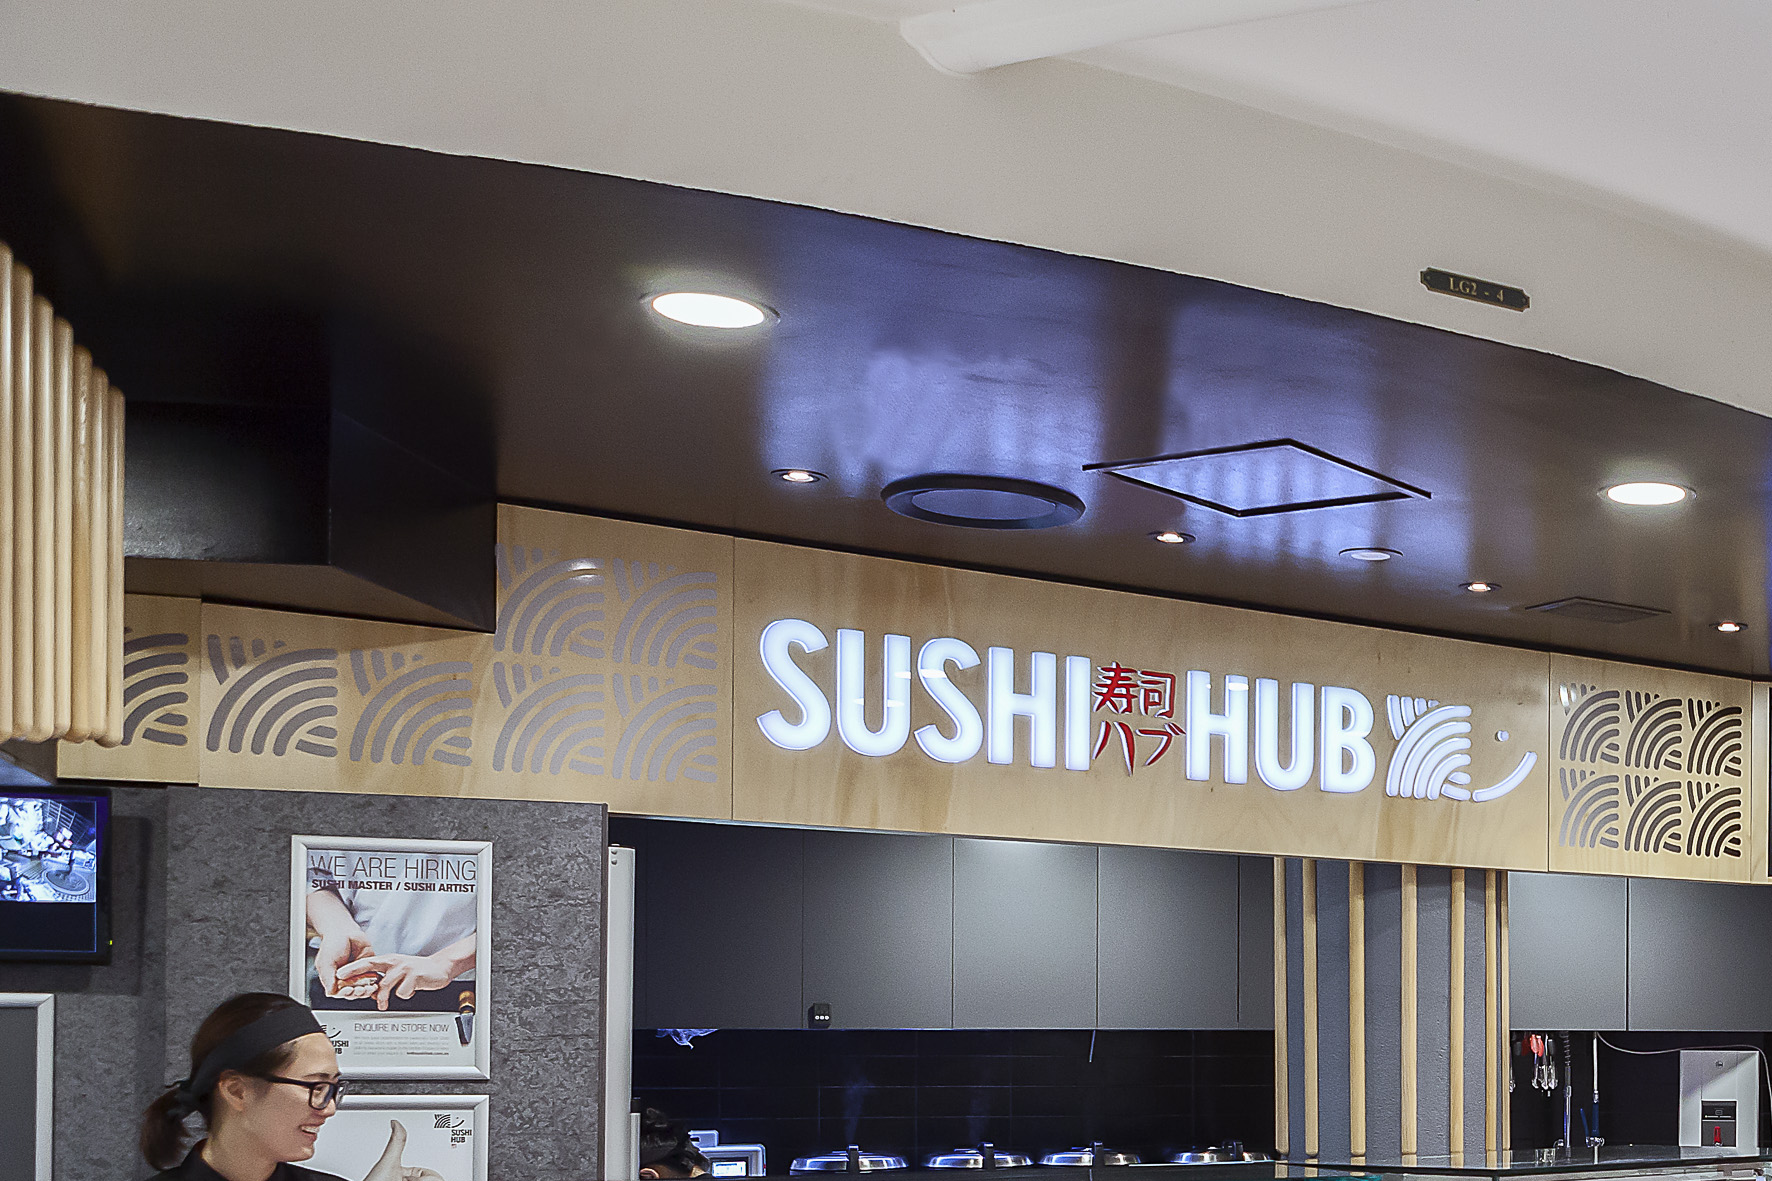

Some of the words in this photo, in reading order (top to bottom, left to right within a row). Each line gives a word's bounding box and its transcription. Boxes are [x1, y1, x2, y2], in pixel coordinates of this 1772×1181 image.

[1450, 278, 1477, 295] LG2
[1496, 290, 1504, 301] 4
[1092, 661, 1178, 718] 寿司
[756, 619, 1091, 771] SUSHI
[1186, 670, 1376, 793] HUB
[310, 855, 346, 877] WE
[352, 856, 397, 879] ARE
[405, 858, 477, 881] HIRING
[311, 879, 345, 889] SUSHI
[347, 880, 392, 891] MASTER
[404, 882, 436, 892] SUSHI
[438, 883, 476, 893] ARTIST
[354, 1023, 388, 1032] ENQUIRE
[390, 1023, 399, 1032] IN
[401, 1023, 427, 1032] STORE
[429, 1024, 449, 1033] NOW
